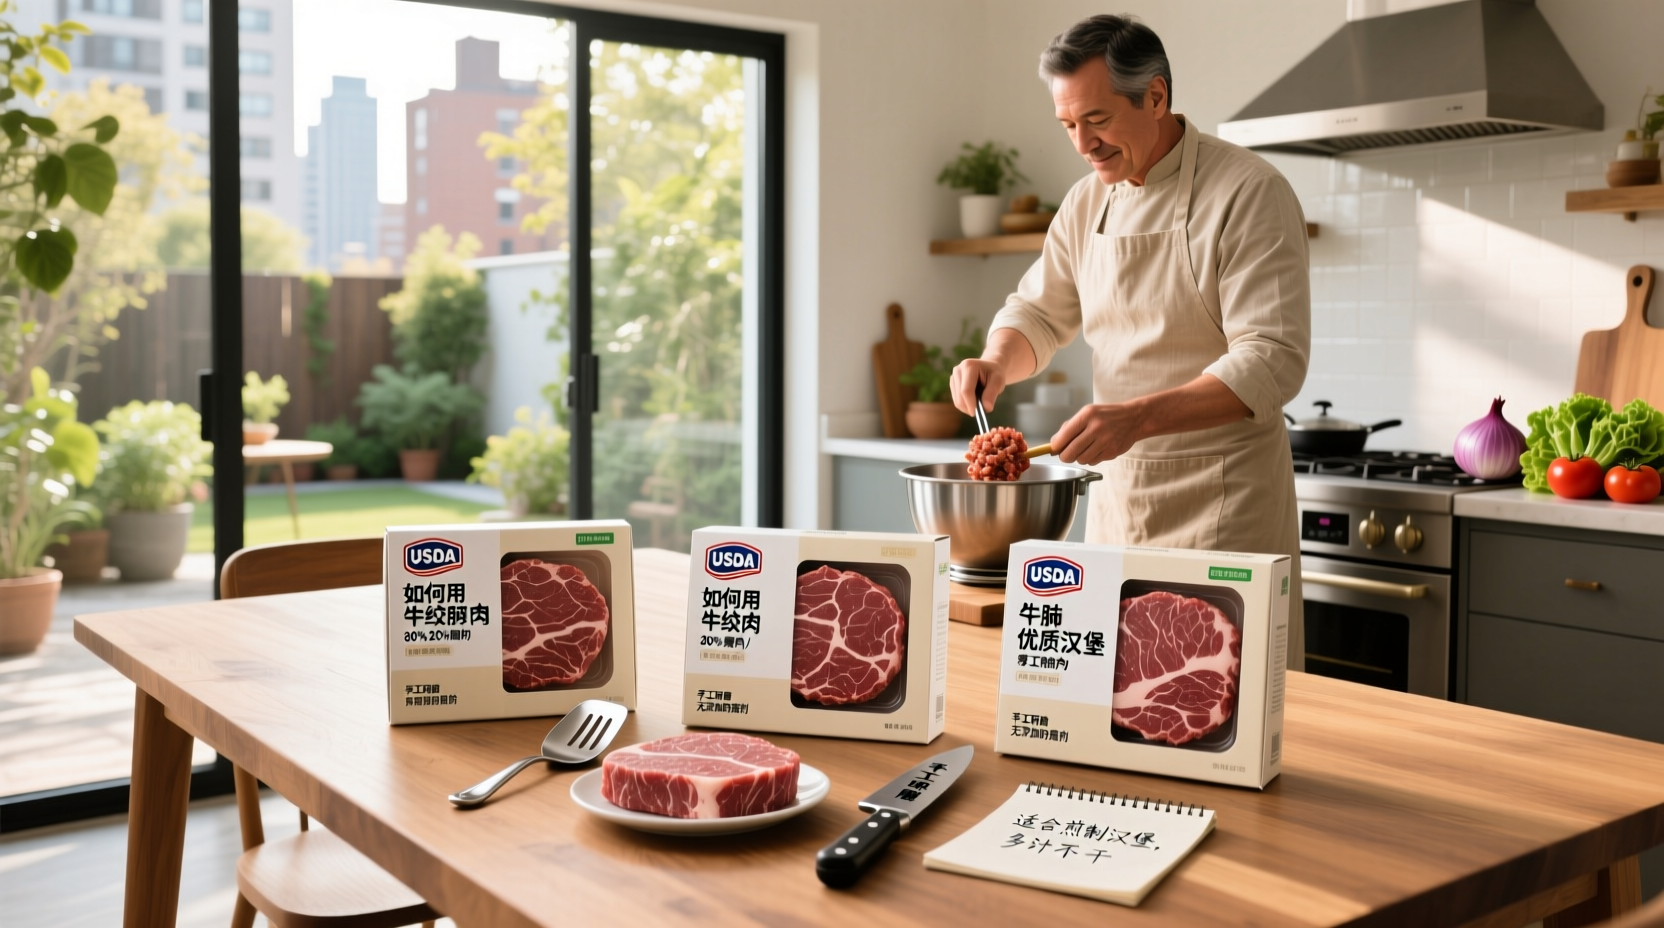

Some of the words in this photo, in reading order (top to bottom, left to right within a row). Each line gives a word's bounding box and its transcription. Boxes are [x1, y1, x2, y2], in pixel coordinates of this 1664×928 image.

[410, 548, 456, 564] USDA
[712, 551, 755, 568] USDA
[1031, 565, 1076, 585] USDA
[402, 581, 466, 604] 如何用
[701, 586, 761, 610] 如何用
[701, 608, 761, 635] 牛绞肉
[1017, 627, 1105, 657] 优质汉堡
[1000, 832, 1112, 864] 多汁不干
